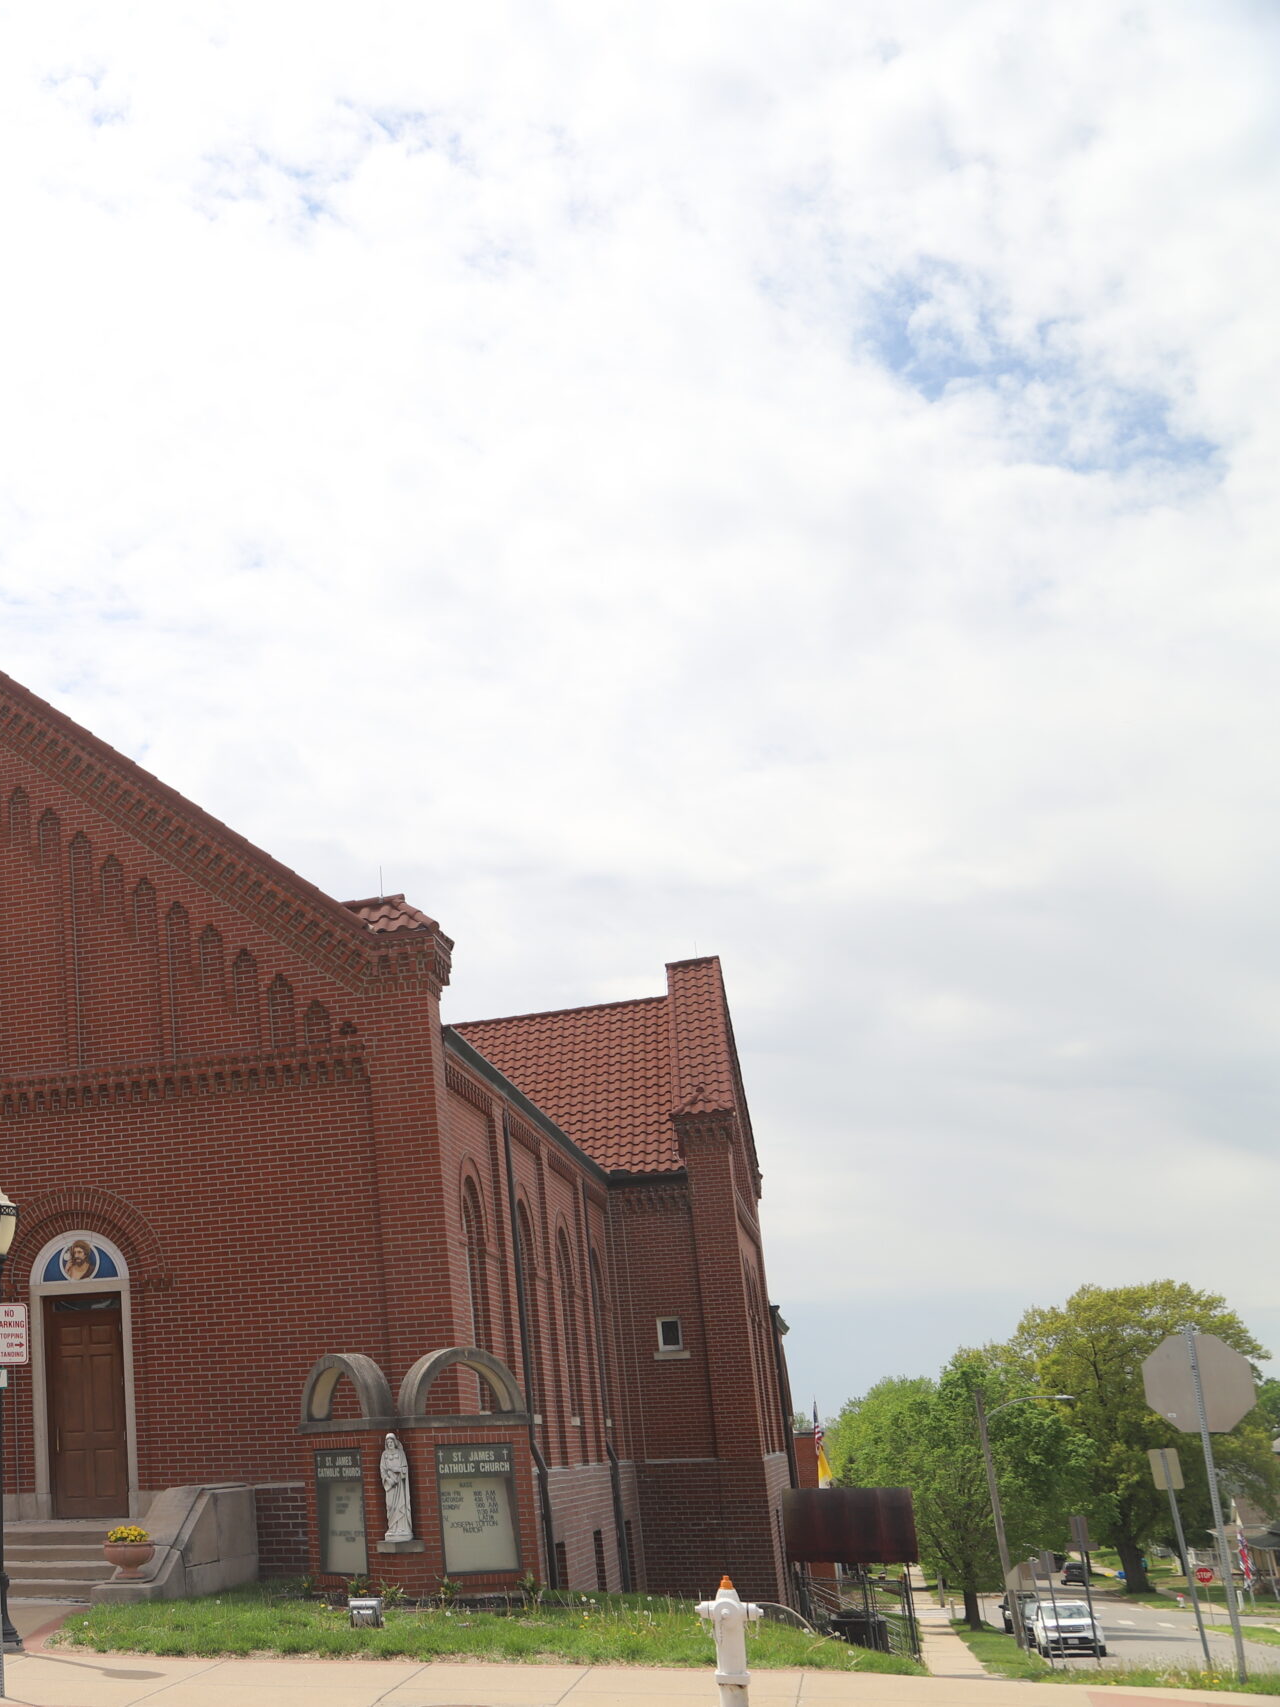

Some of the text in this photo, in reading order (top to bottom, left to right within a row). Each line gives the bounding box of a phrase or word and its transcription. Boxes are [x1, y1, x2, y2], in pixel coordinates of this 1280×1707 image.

[4, 1309, 15, 1318] NO
[325, 1456, 352, 1466] ST. JAMES
[452, 1451, 495, 1462] ST. JAMES
[318, 1467, 361, 1478] CATHOLIC CHURCH
[439, 1462, 510, 1474] CATHOLIC CHURCH
